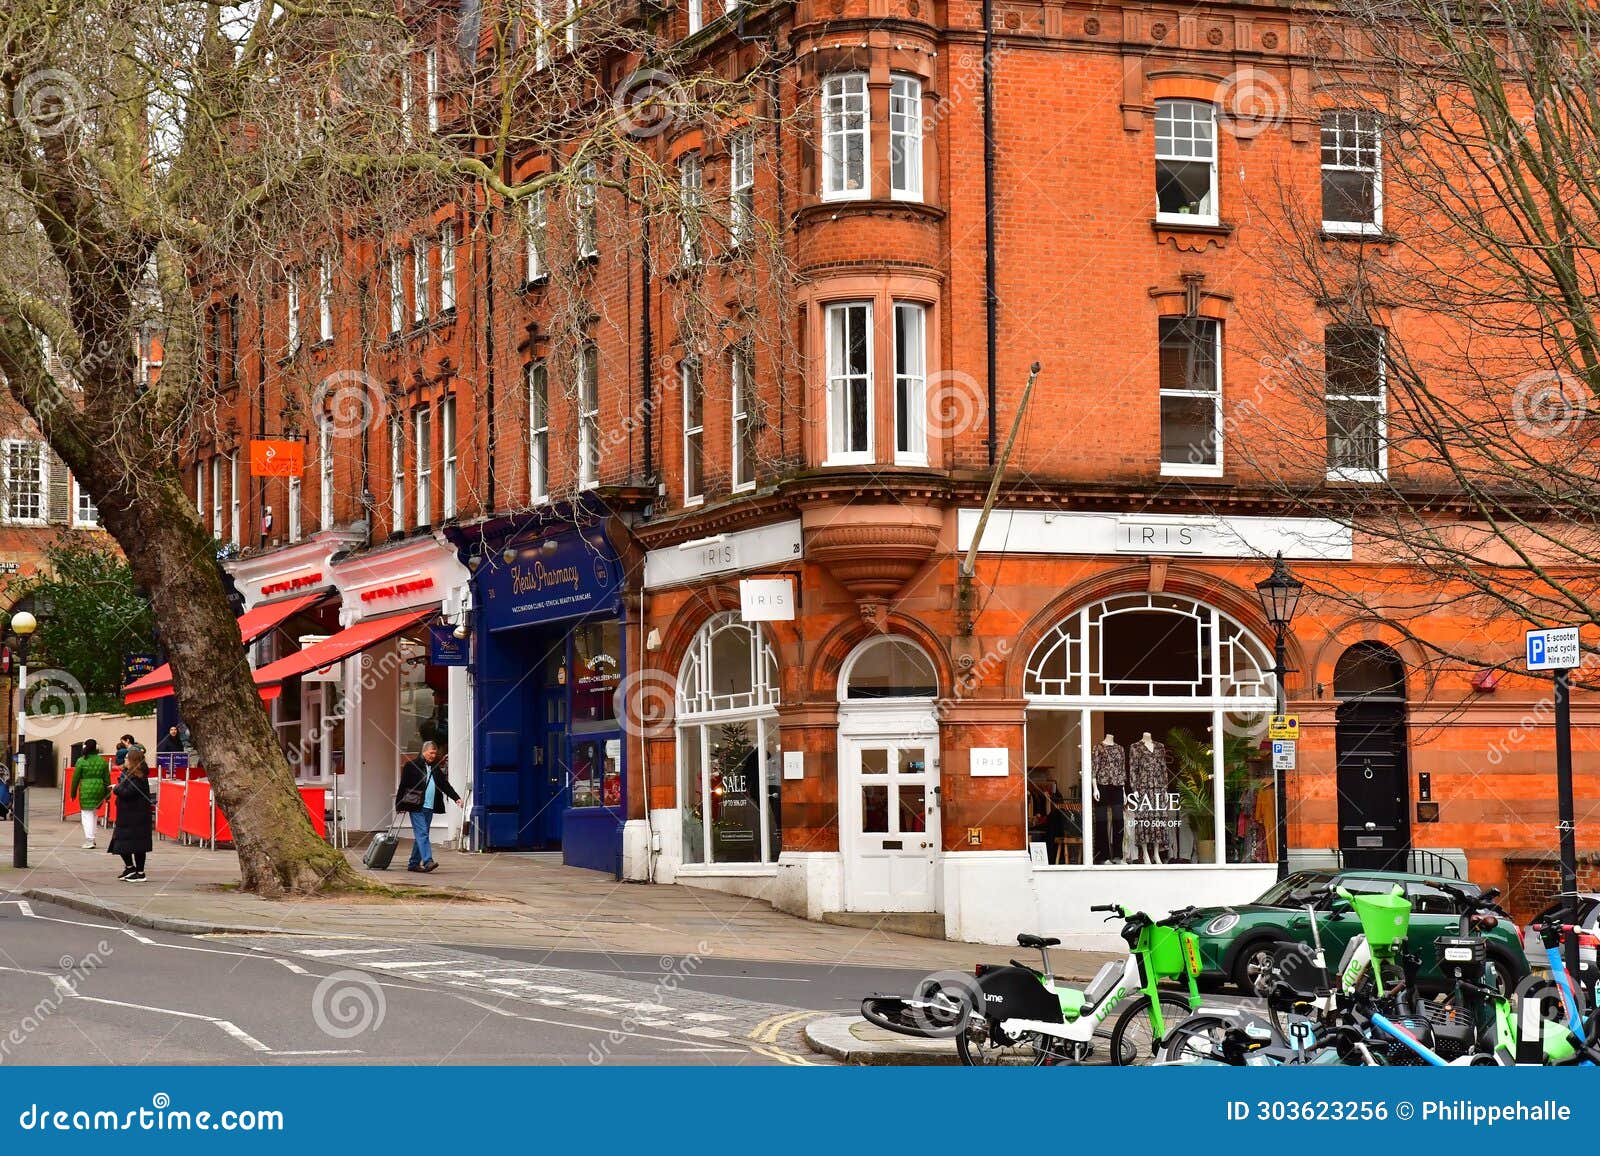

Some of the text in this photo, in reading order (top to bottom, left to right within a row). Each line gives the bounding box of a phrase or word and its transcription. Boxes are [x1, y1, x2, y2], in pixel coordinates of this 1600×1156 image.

[1128, 527, 1192, 545] IRIS
[793, 543, 800, 554] 28
[702, 546, 732, 566] IRIS
[511, 565, 536, 595] Keats
[535, 561, 579, 591] Pharmacy
[751, 594, 784, 605] IRIS
[1546, 632, 1576, 642] E-scooter
[1532, 639, 1576, 662] P and cycle
[1548, 655, 1576, 664] hire only
[976, 757, 1004, 767] IRIS
[722, 775, 747, 793] SALE
[1127, 792, 1182, 812] SALE
[1140, 820, 1151, 828] TO
[1151, 820, 1167, 828] 50%
[1167, 820, 1182, 828] OFF
[983, 992, 1004, 1003] Lime
[1095, 986, 1128, 1023] Lime
